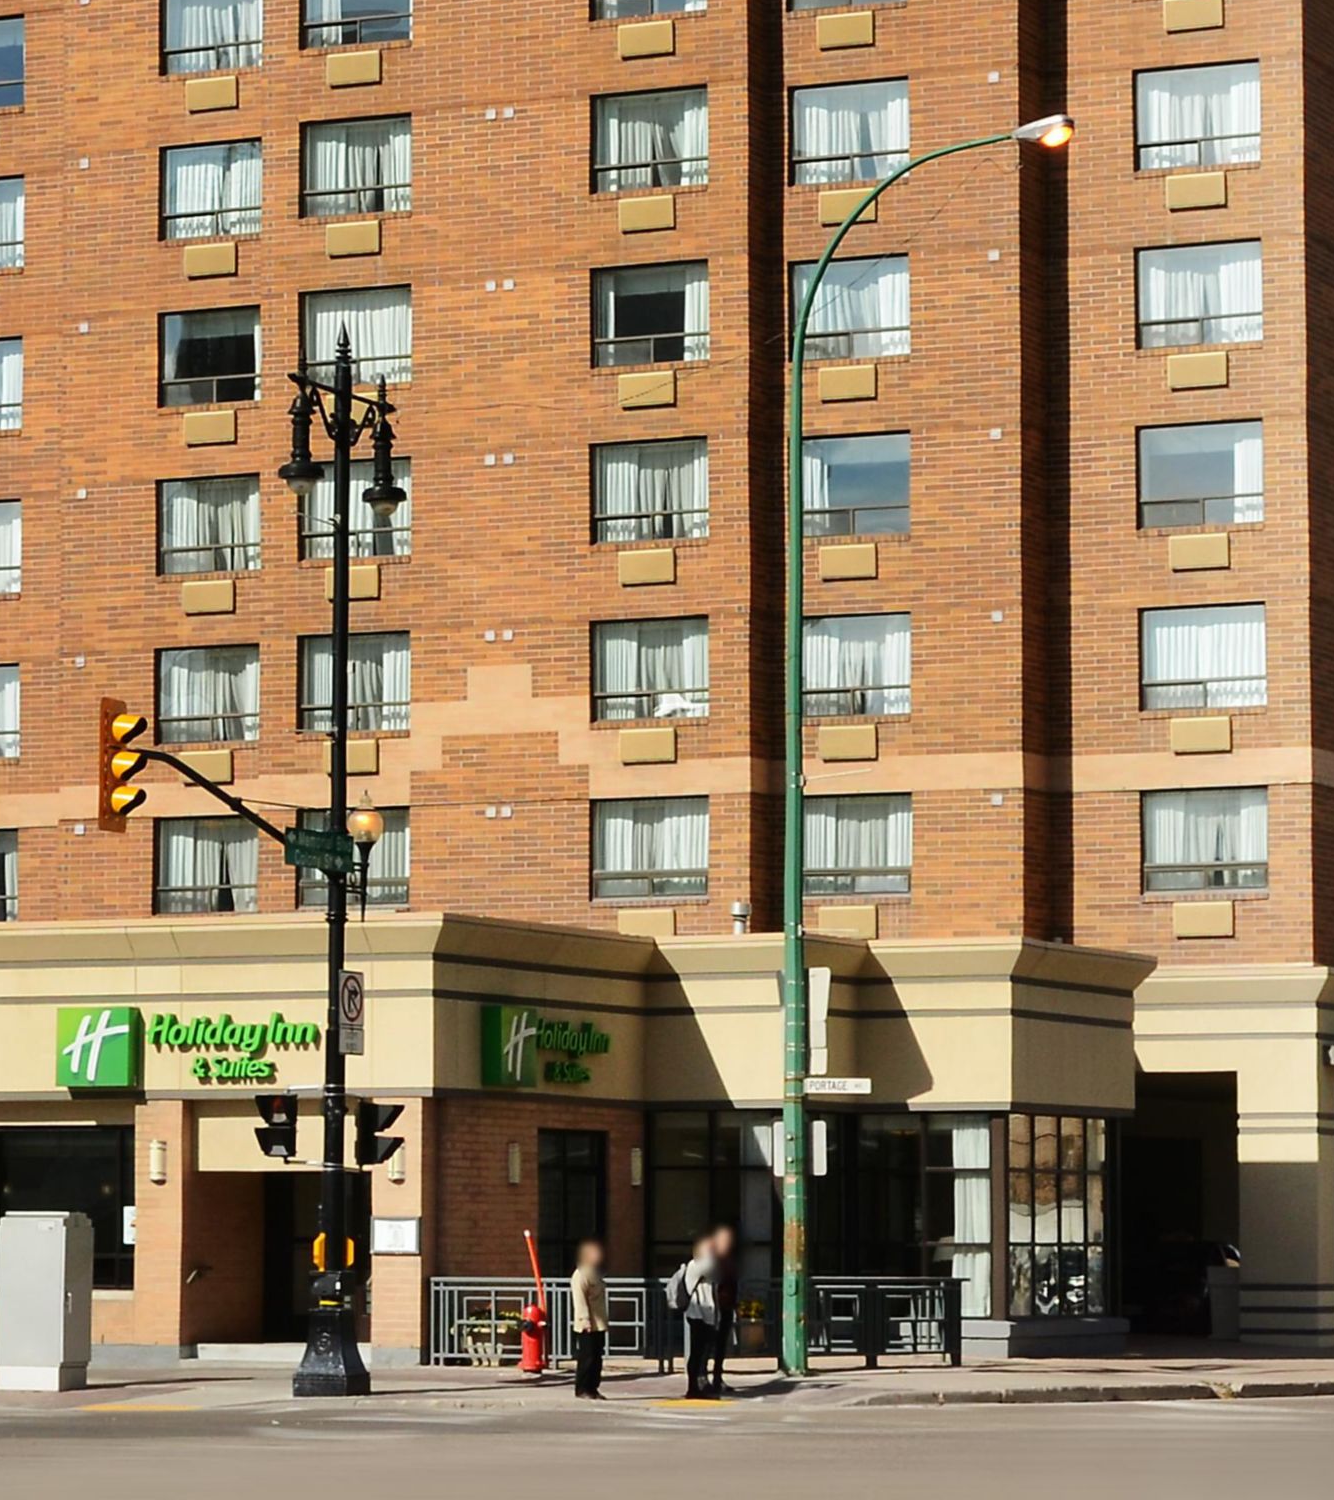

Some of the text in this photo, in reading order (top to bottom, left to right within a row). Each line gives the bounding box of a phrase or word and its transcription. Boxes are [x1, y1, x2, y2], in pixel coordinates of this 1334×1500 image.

[146, 1012, 265, 1051] Holiday
[267, 1011, 319, 1045] Inn
[536, 1018, 610, 1057] Holiday Inn
[190, 1056, 272, 1078] & Suites
[809, 1080, 848, 1091] PORTAGE
